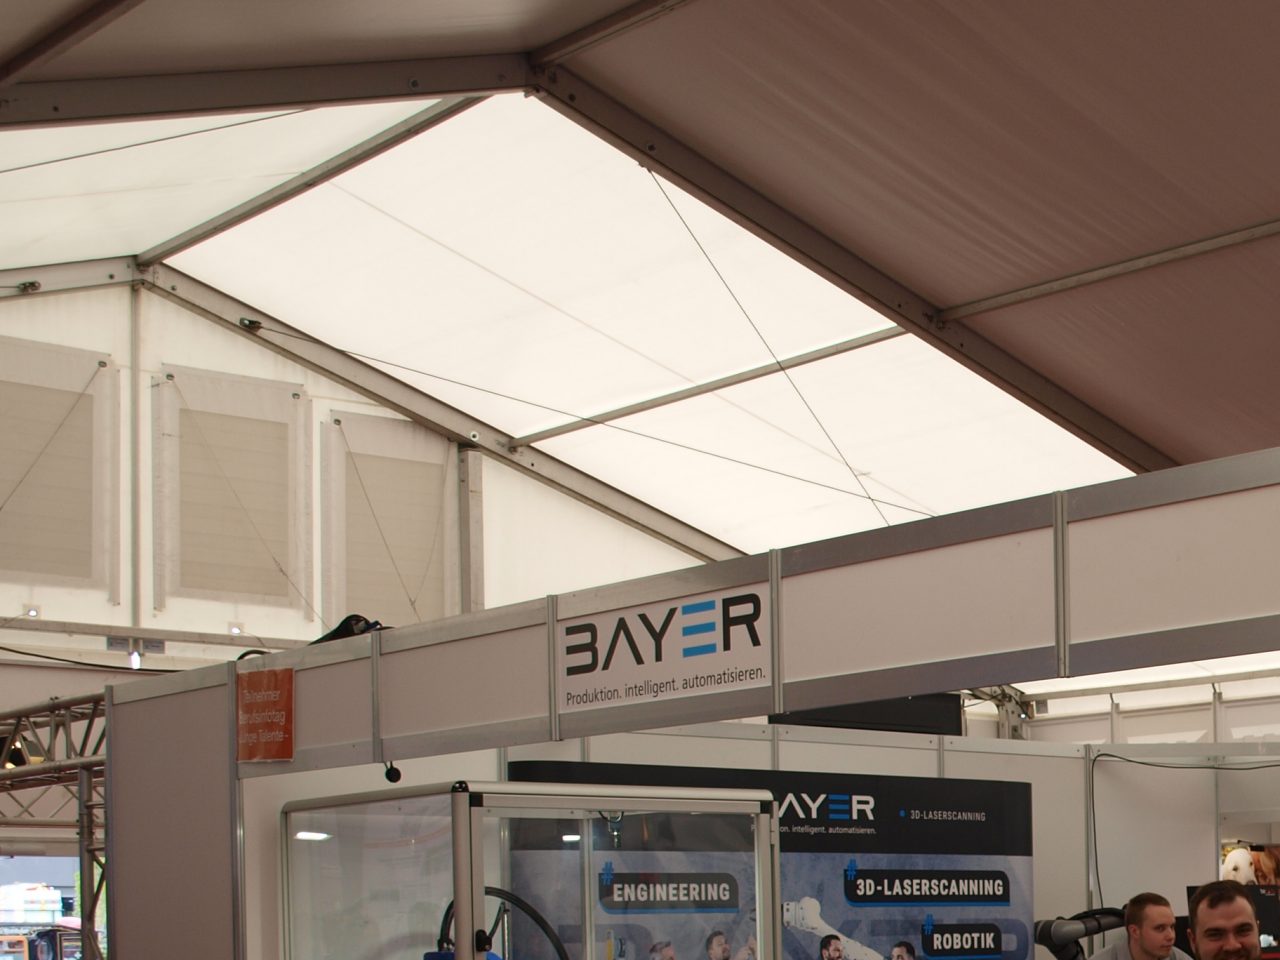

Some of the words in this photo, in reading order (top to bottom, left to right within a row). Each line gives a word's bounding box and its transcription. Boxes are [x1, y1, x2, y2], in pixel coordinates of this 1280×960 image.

[565, 592, 762, 677] BAYER
[565, 685, 622, 707] Produktion.
[624, 677, 679, 699] intelligent.
[681, 667, 767, 691] automatisieren.
[778, 792, 875, 821] AYER
[909, 809, 986, 822] 3D-LASERSCANNING
[613, 882, 730, 903] ENGINEERING
[856, 877, 1004, 897] 3D-LASERSCANNING
[933, 932, 995, 950] ROBOTIK
